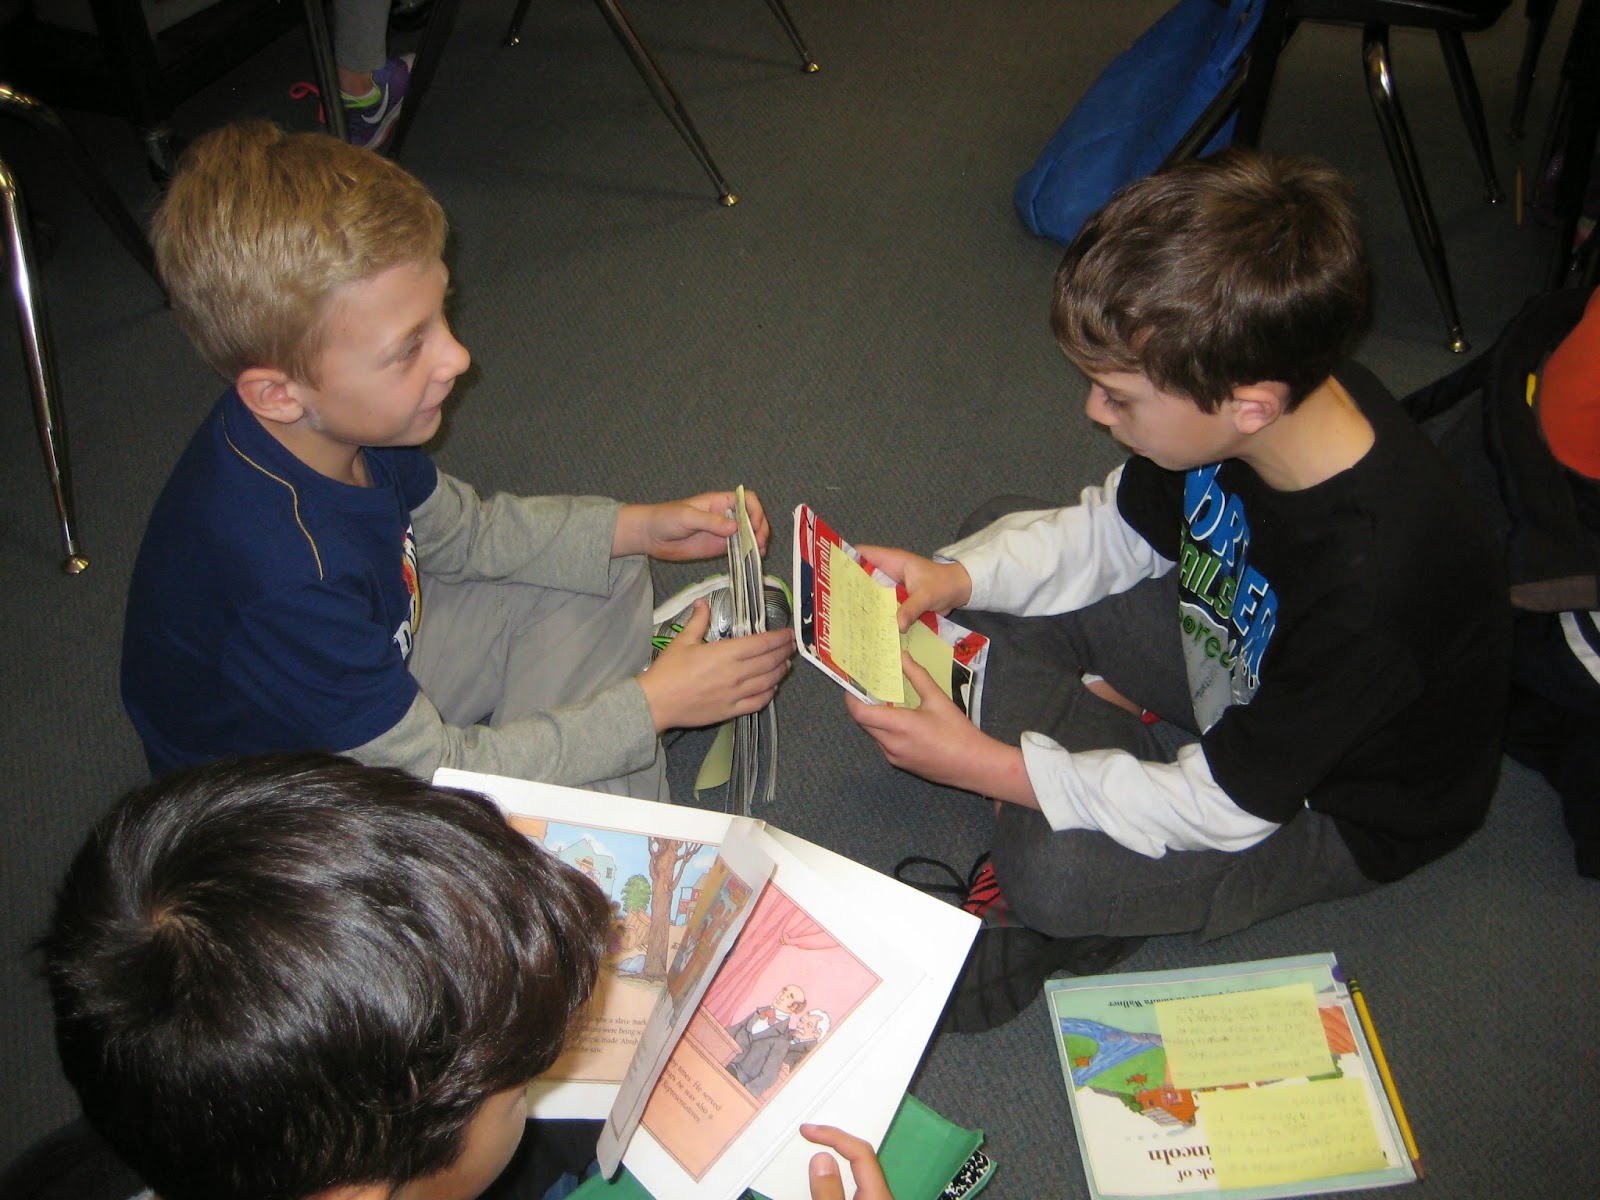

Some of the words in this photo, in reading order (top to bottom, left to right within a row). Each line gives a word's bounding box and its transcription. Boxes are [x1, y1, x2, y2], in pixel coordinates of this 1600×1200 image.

[816, 536, 832, 591] Lincoln
[1179, 532, 1237, 620] AILS
[817, 592, 831, 654] Abraham
[1107, 998, 1143, 1009] Wallner
[632, 1018, 646, 1026] mark
[618, 1028, 635, 1037] being
[620, 1038, 639, 1046] Abrah
[685, 1089, 696, 1101] was
[696, 1101, 709, 1114] also
[692, 1081, 702, 1092] He
[703, 1091, 722, 1111] served
[1147, 1145, 1213, 1166] incoln
[1176, 1168, 1193, 1183] of
[1196, 1167, 1216, 1182] ok
